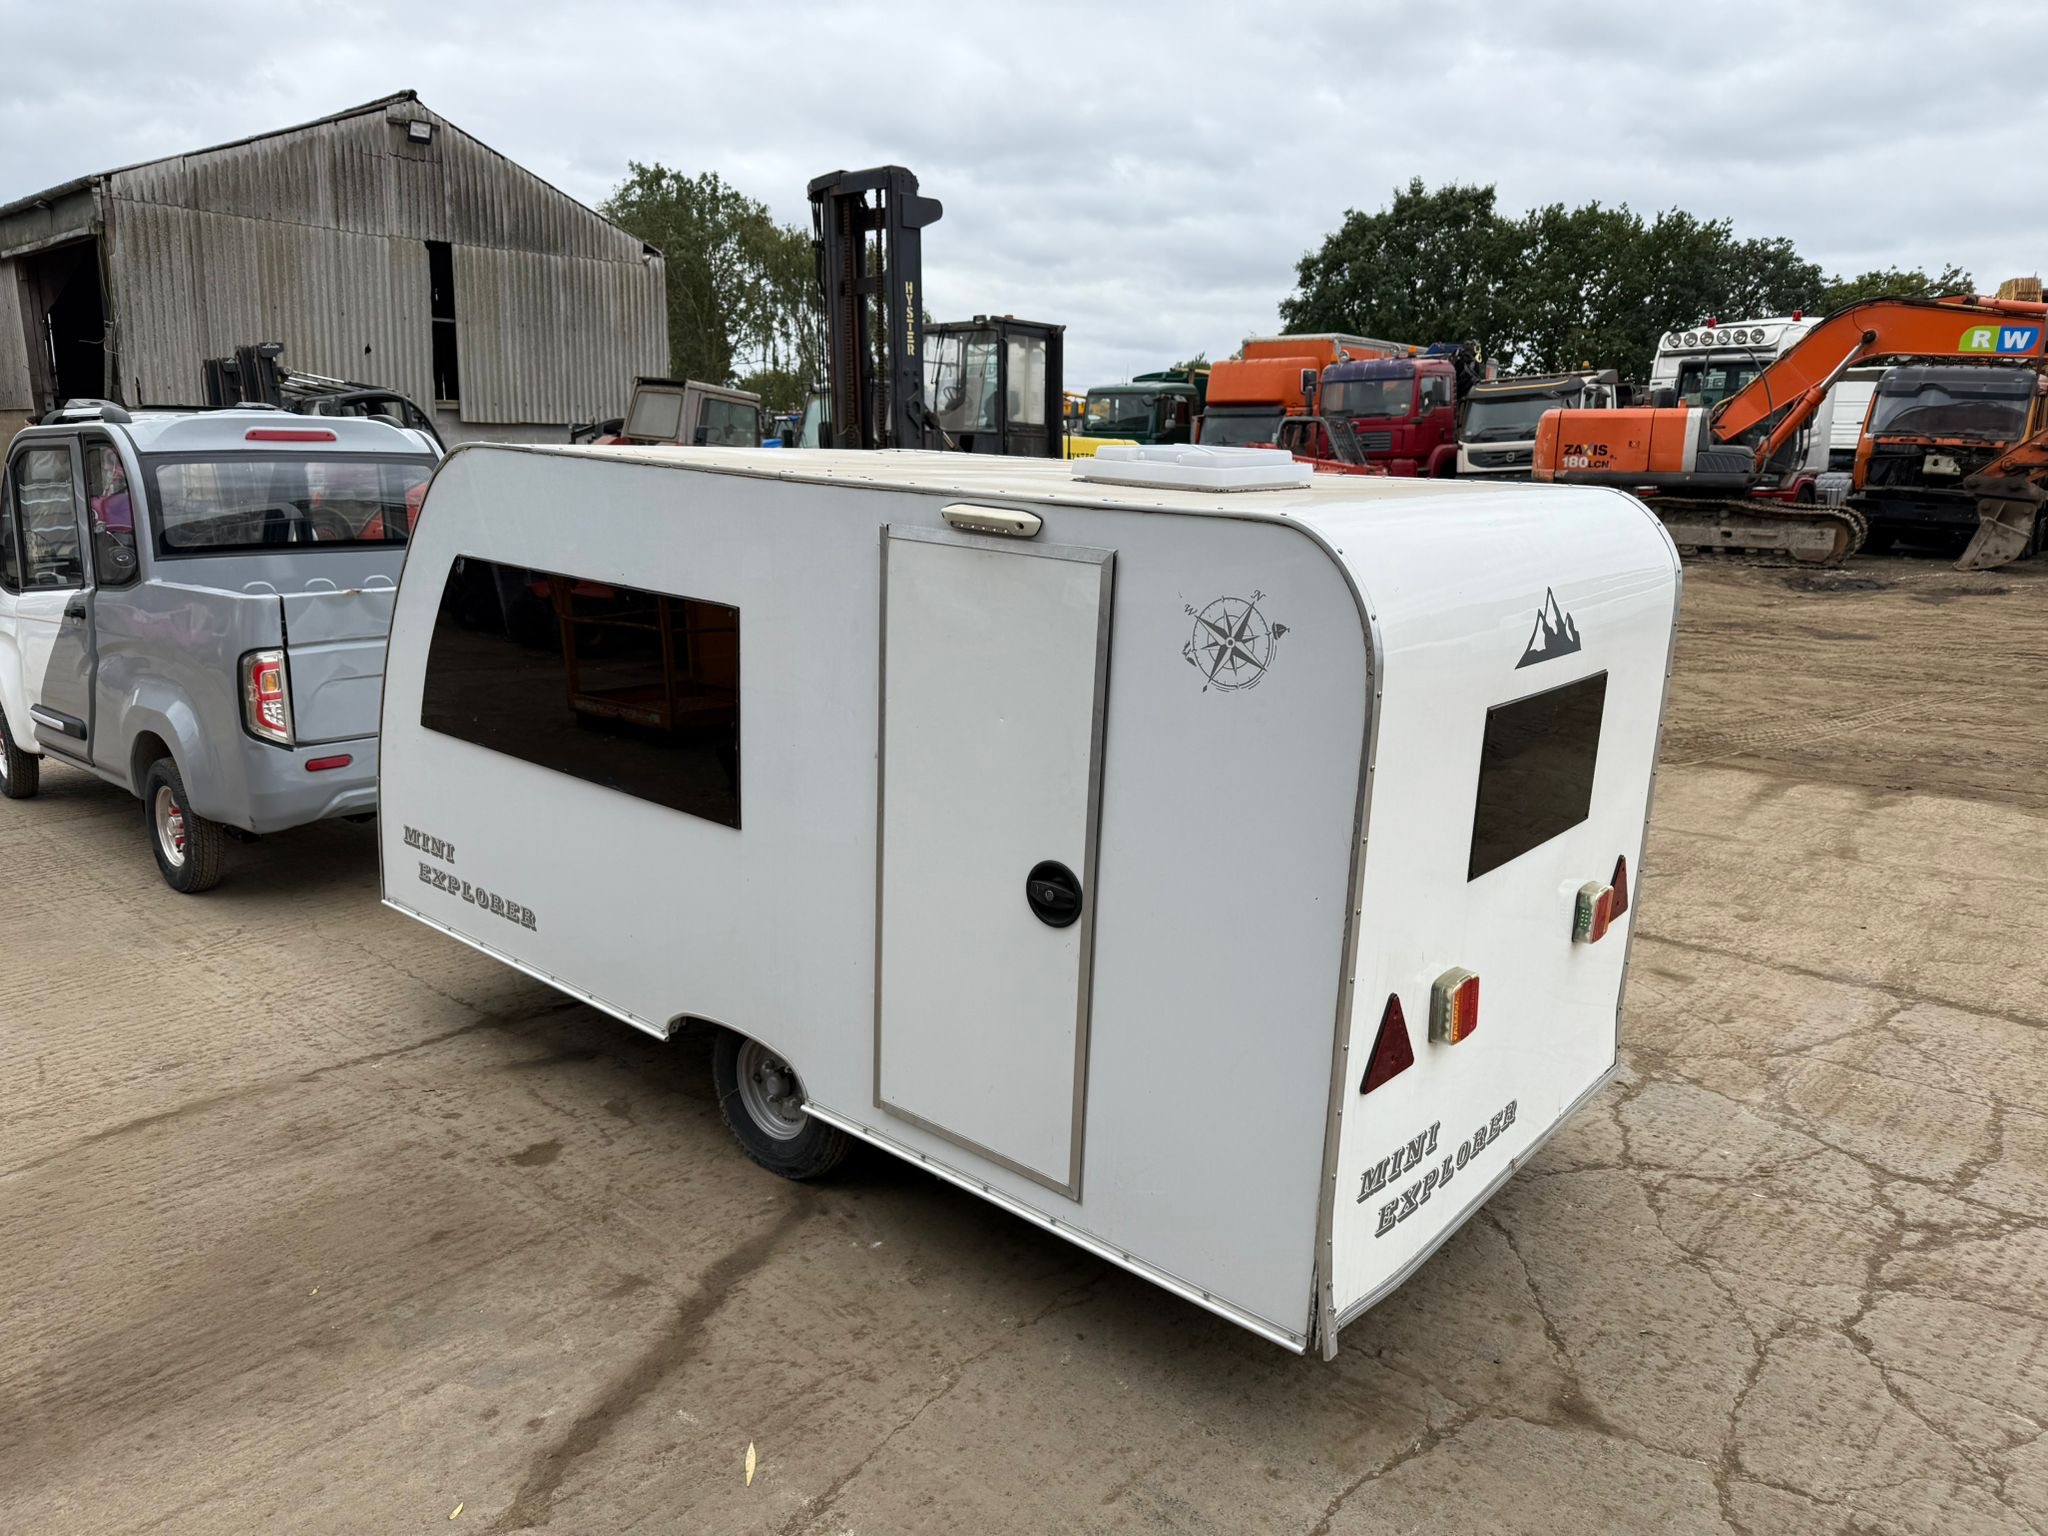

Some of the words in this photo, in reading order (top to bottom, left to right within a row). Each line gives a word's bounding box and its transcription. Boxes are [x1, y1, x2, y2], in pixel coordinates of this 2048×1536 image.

[905, 281, 915, 356] HYSTER
[1563, 443, 1608, 456] ZAXIS
[403, 824, 455, 864] MINI
[418, 861, 537, 932] EXPLORER
[1356, 1119, 1440, 1204] MINI
[1374, 1098, 1518, 1238] EXPLORER
